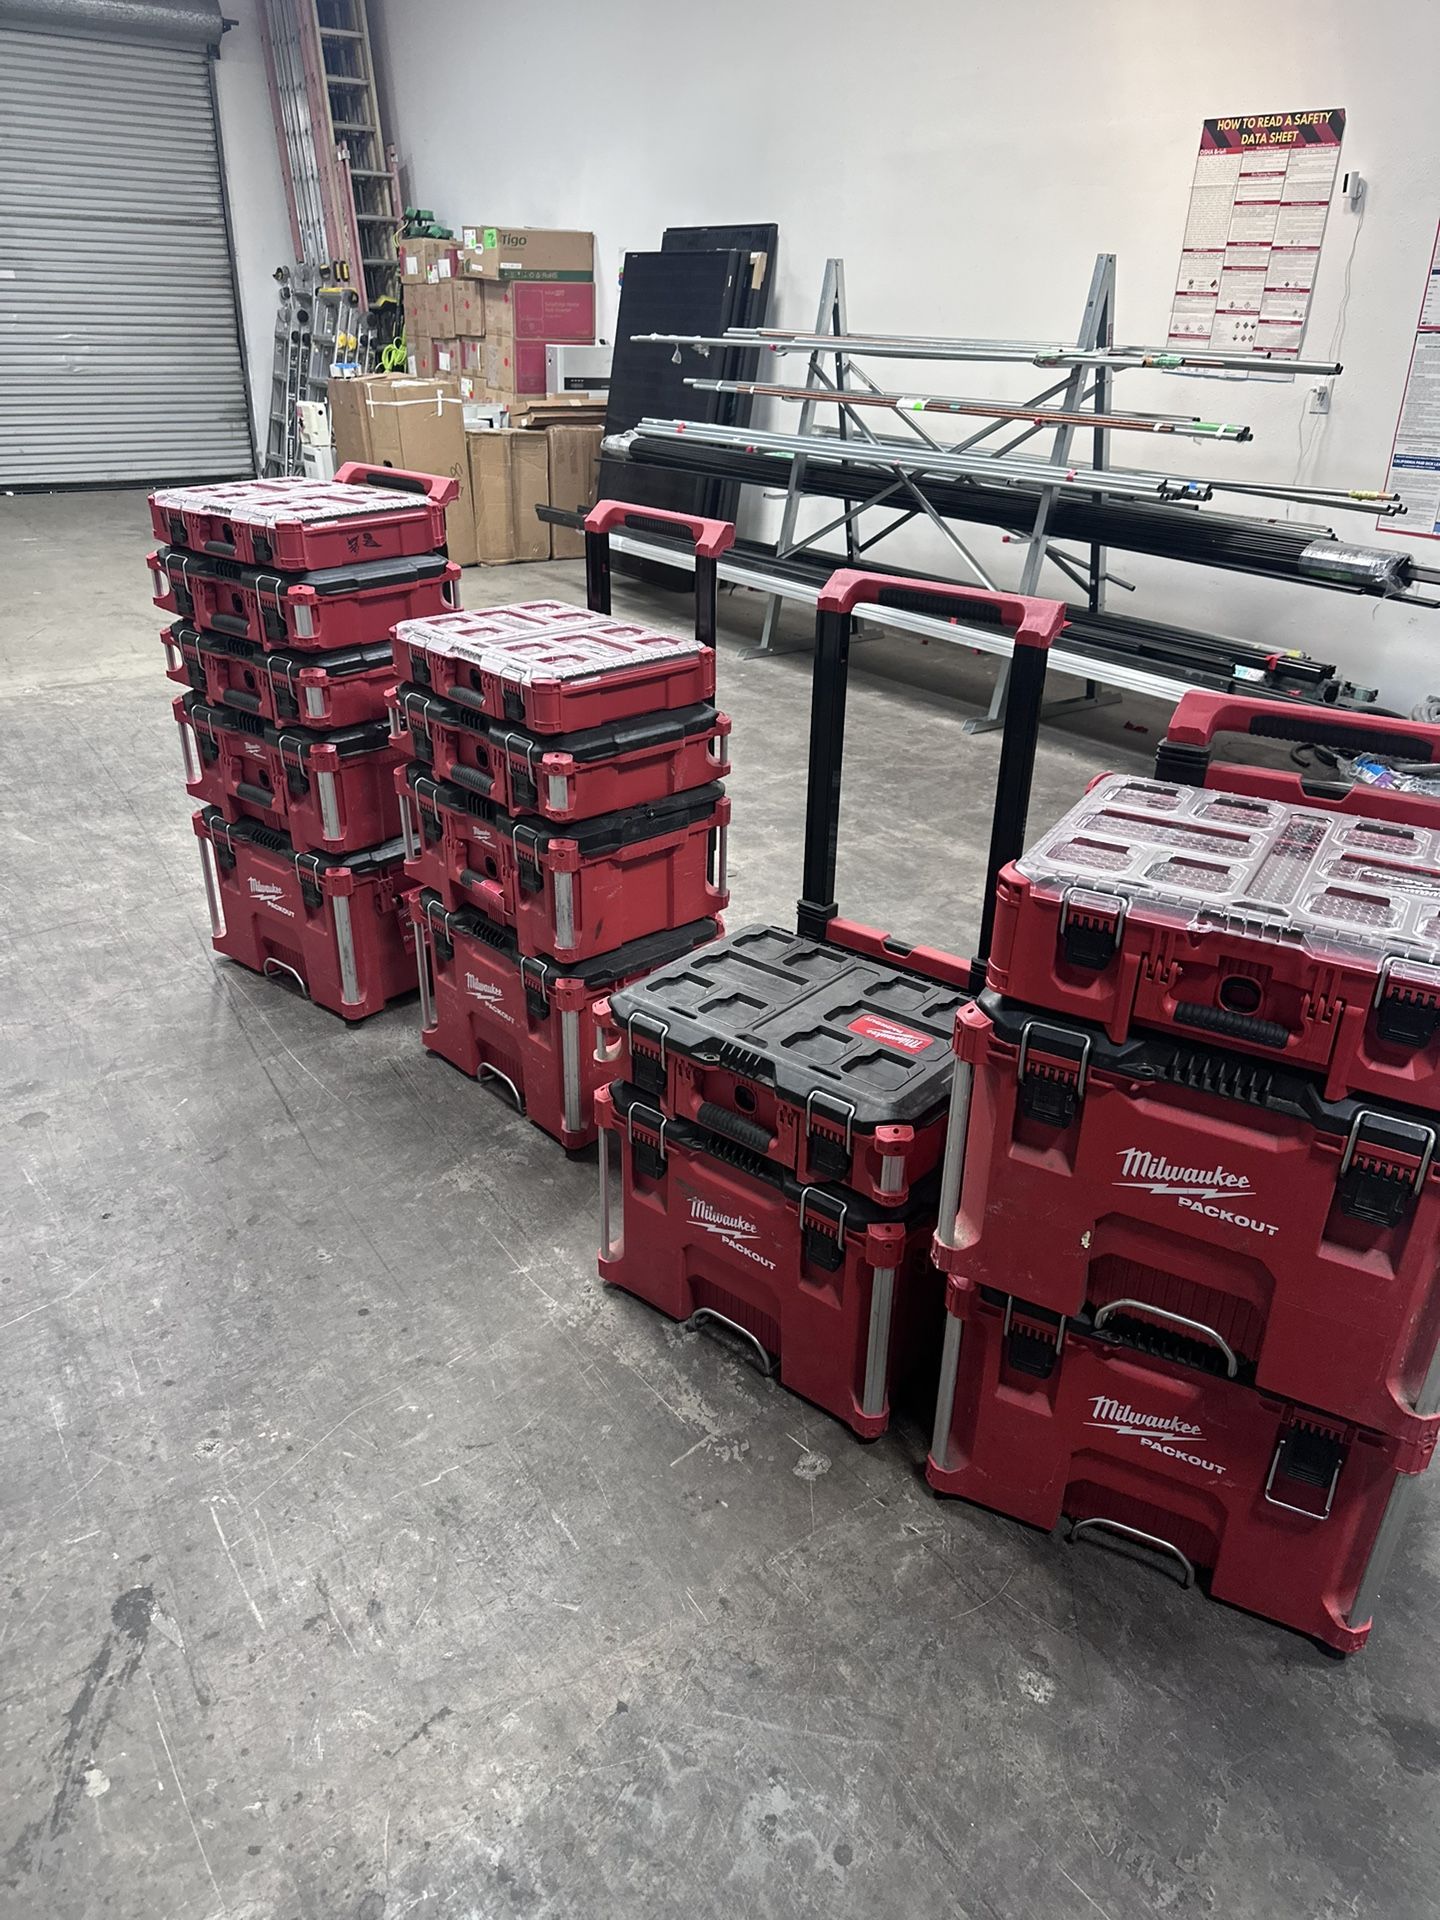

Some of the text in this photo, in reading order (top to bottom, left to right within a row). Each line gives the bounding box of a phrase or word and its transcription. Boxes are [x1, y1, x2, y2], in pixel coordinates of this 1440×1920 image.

[1217, 111, 1333, 131] HOW TO READ A SAFETY
[1241, 131, 1299, 145] DATA SHEET
[502, 233, 527, 247] Tigo
[247, 876, 283, 894] Milwaukee
[1363, 871, 1433, 888] PACKOUT
[464, 972, 503, 997] Milwaukee
[484, 1000, 514, 1024] PACKOUT
[866, 1029, 923, 1049] Milwaukee
[1116, 1147, 1251, 1189] Milwaukee
[687, 1196, 758, 1233] Milwaukee
[1178, 1196, 1279, 1236] PACKOUT
[721, 1235, 776, 1270] PACKOUT
[1088, 1395, 1202, 1435] Milwaukee
[1140, 1437, 1227, 1475] PACKOUT
